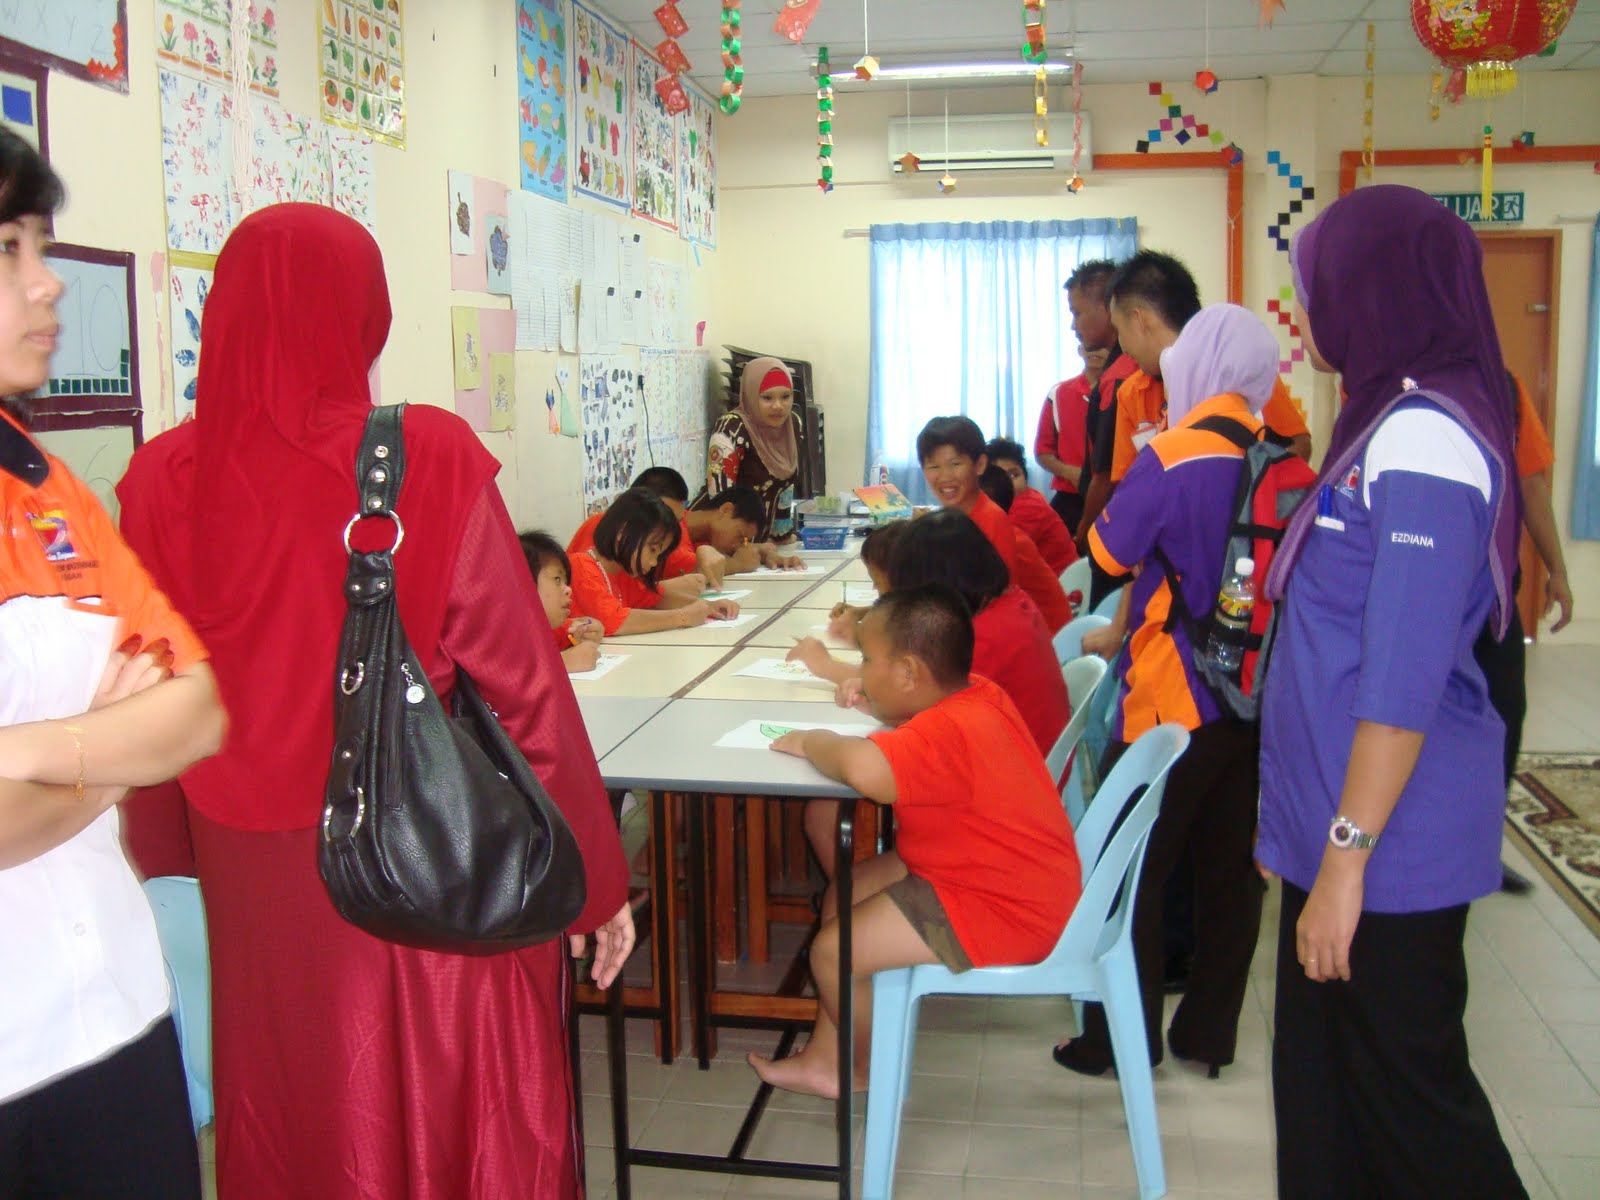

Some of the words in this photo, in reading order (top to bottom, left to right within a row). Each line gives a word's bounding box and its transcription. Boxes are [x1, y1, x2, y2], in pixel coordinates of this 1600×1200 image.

[1434, 195, 1499, 220] UAR
[65, 276, 124, 376] 10
[1391, 531, 1434, 549] EZDIANA
